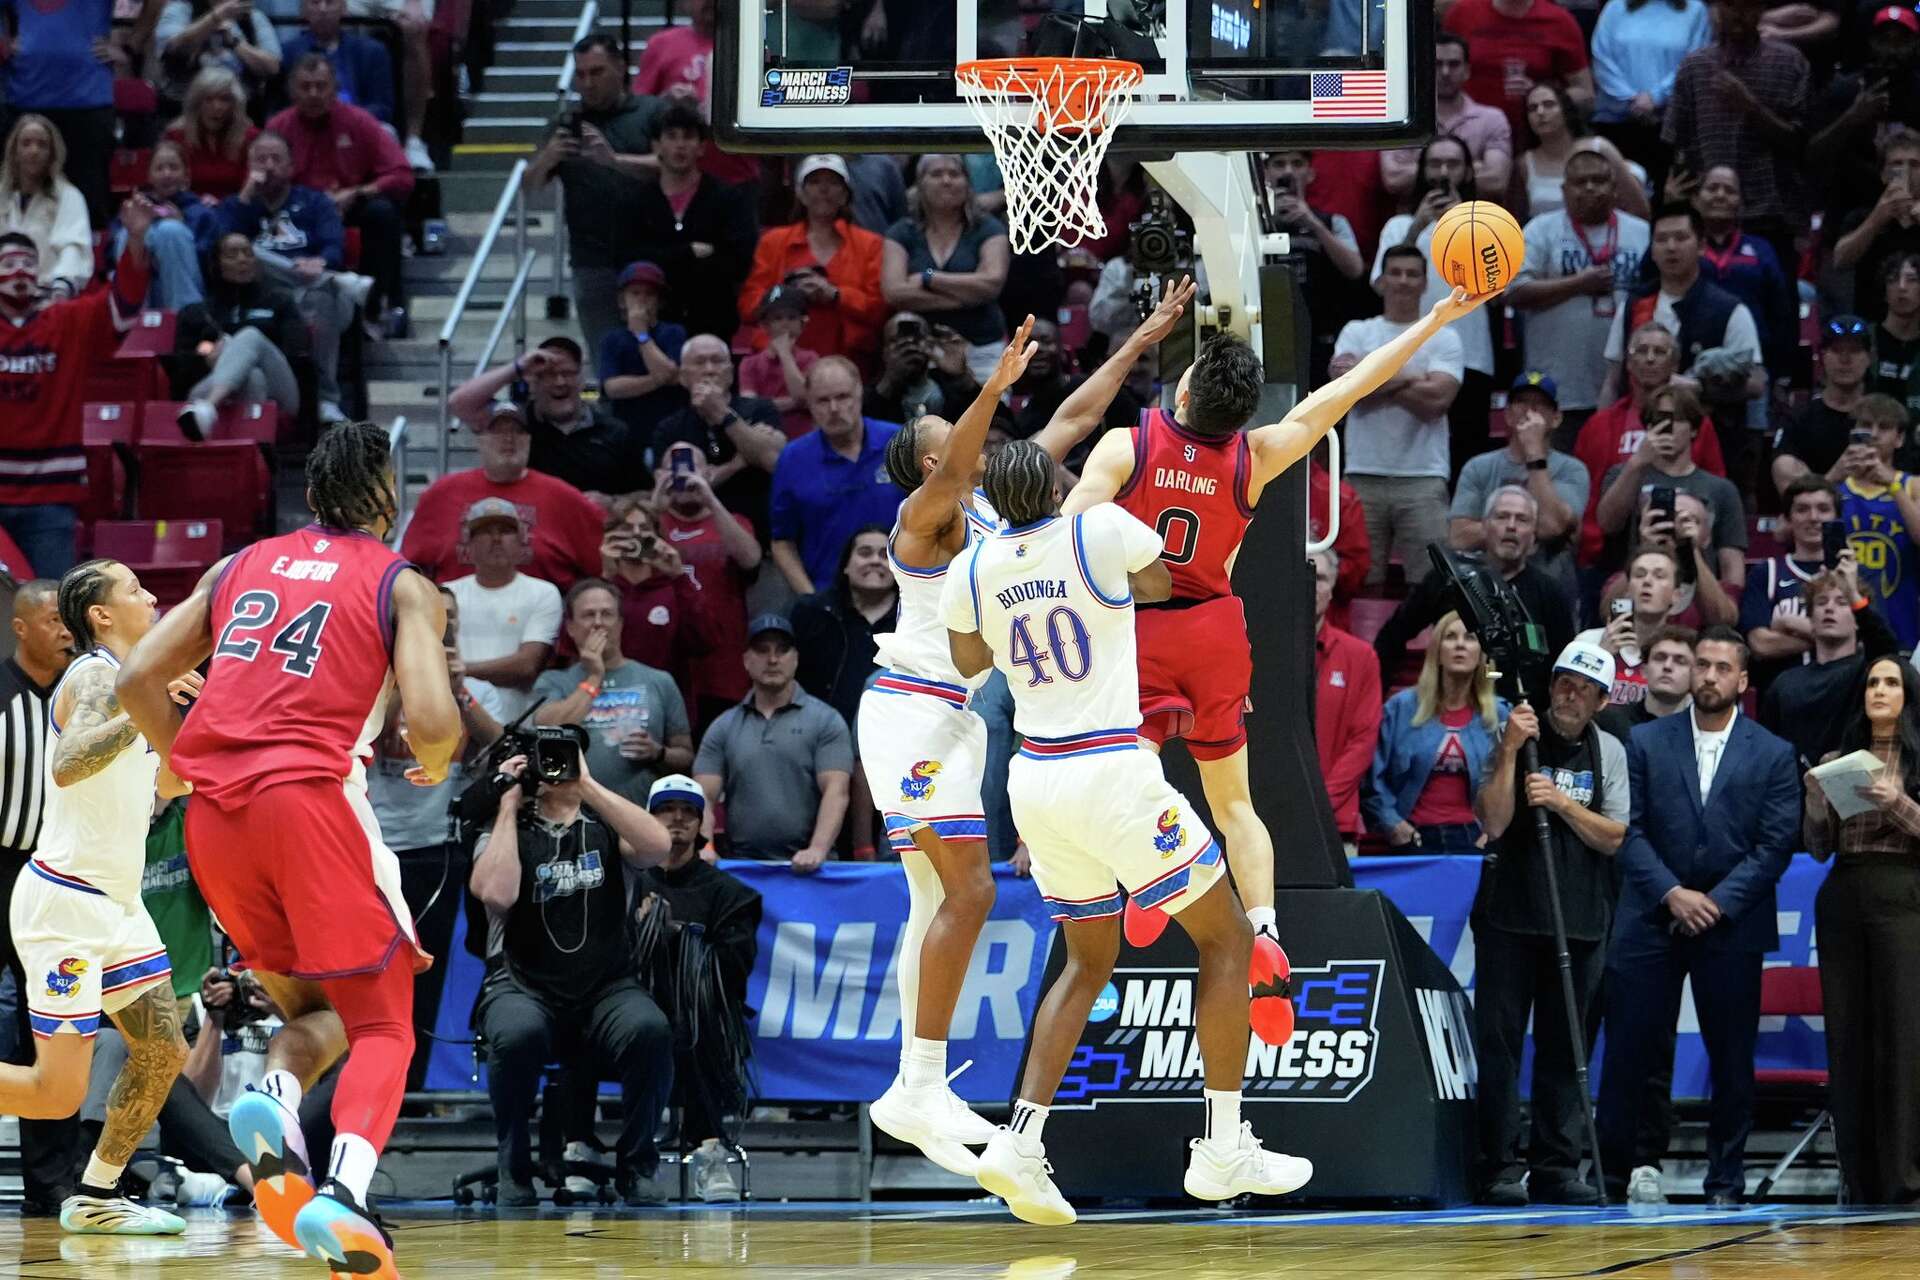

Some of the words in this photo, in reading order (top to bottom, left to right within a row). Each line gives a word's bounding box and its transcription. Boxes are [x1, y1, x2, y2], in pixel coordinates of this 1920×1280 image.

[780, 72, 827, 86] MARCH
[785, 86, 848, 100] MADNESS
[1481, 243, 1501, 293] Wilso
[1154, 467, 1218, 496] DARLING
[1155, 506, 1201, 566] 0
[1851, 514, 1904, 536] ITY
[996, 580, 1068, 610] BIDUNGA
[213, 589, 333, 679] 24
[1009, 605, 1093, 688] 40
[1090, 998, 1118, 1011] CAA
